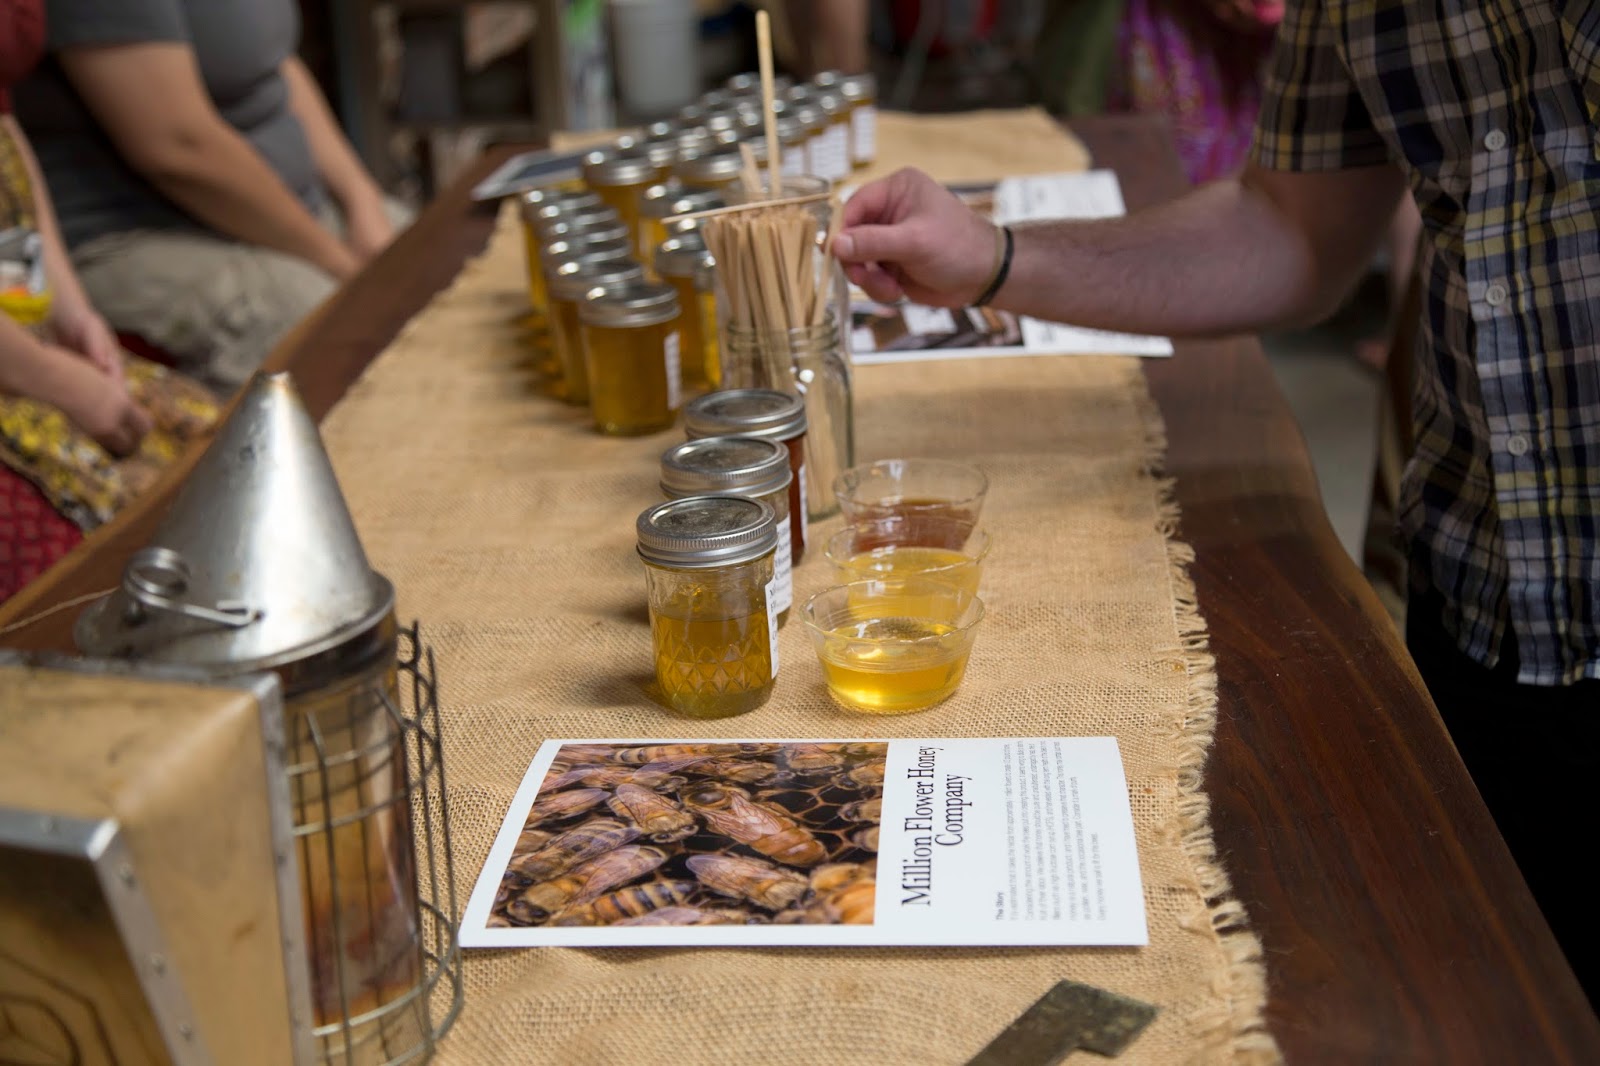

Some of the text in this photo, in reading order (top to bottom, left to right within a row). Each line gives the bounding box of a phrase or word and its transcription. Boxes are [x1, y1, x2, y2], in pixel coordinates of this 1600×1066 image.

[901, 746, 944, 907] Million Flower Honey
[934, 773, 973, 847] Company
[995, 892, 1005, 921] The Story
